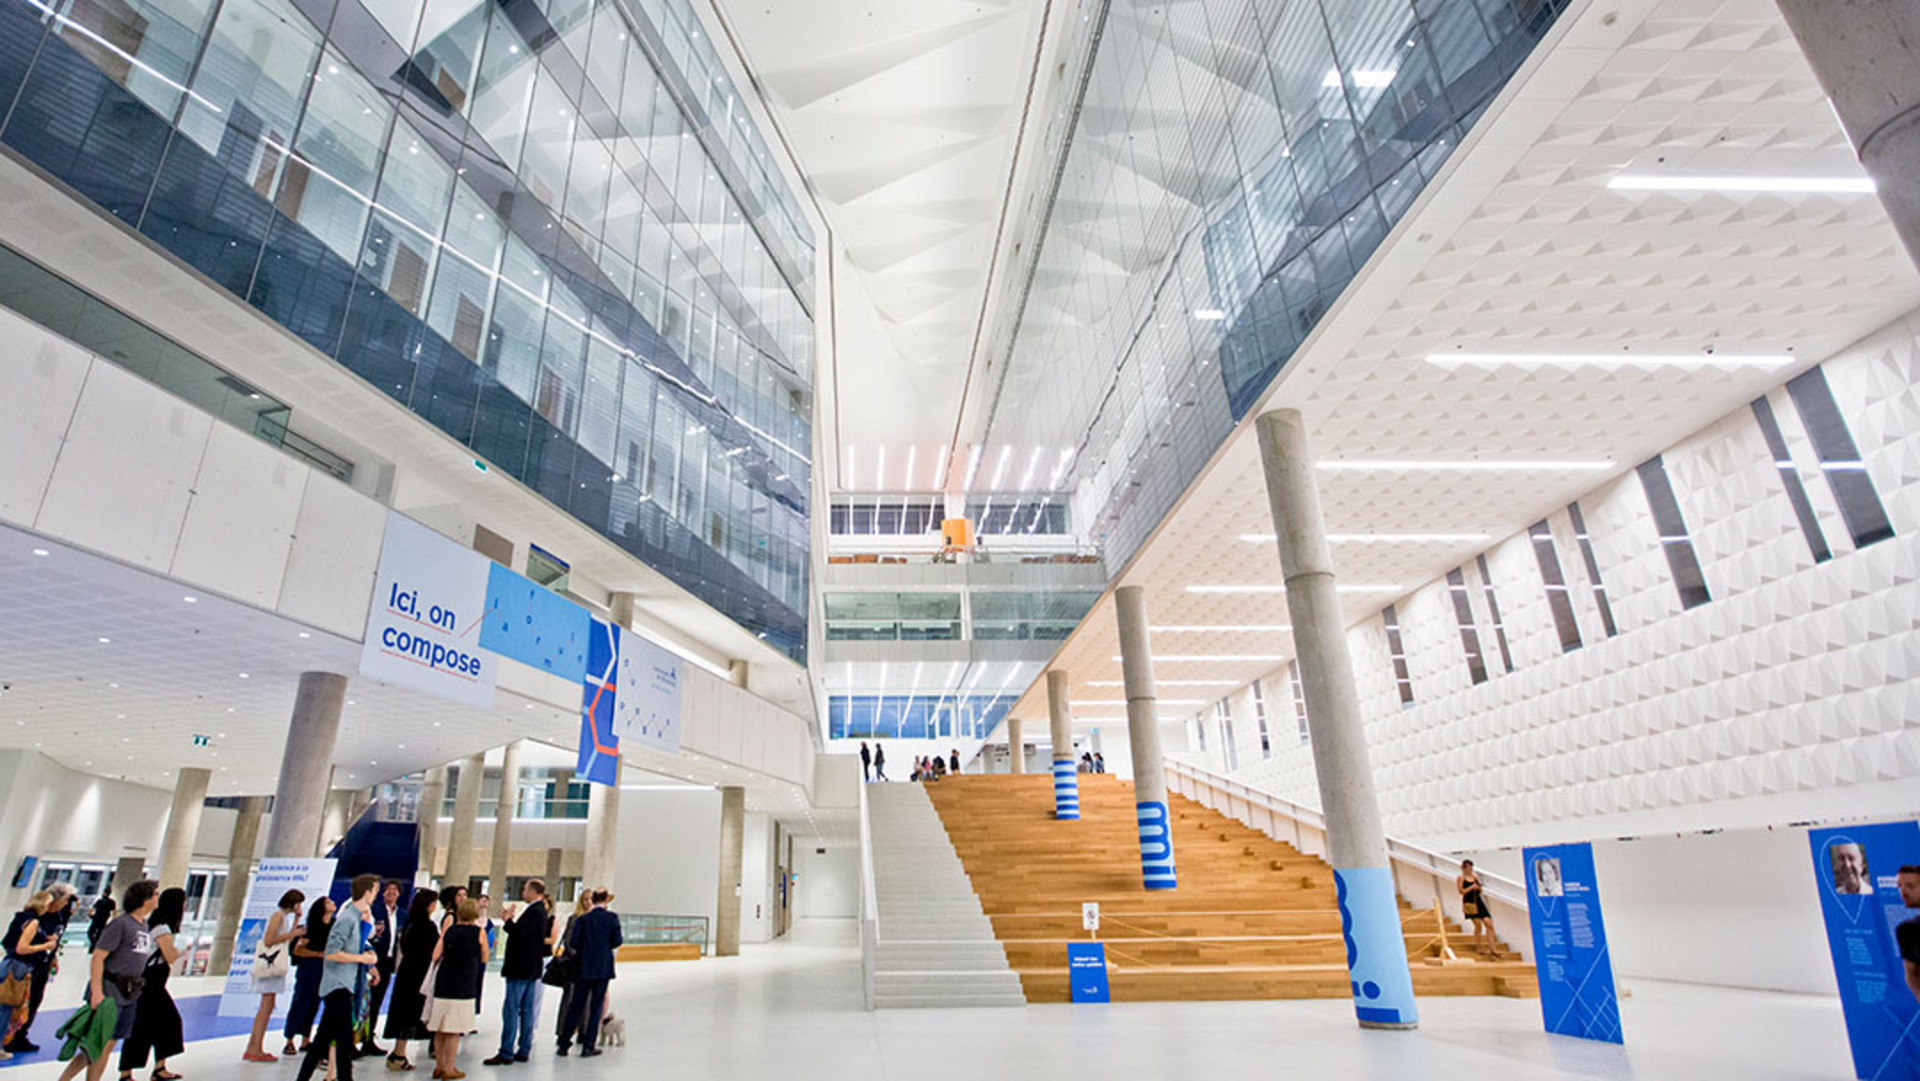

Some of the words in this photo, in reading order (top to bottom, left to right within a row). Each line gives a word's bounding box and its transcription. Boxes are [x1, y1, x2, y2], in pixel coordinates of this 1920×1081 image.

[389, 582, 421, 621] Ici,
[429, 605, 456, 630] on
[382, 627, 481, 676] compose
